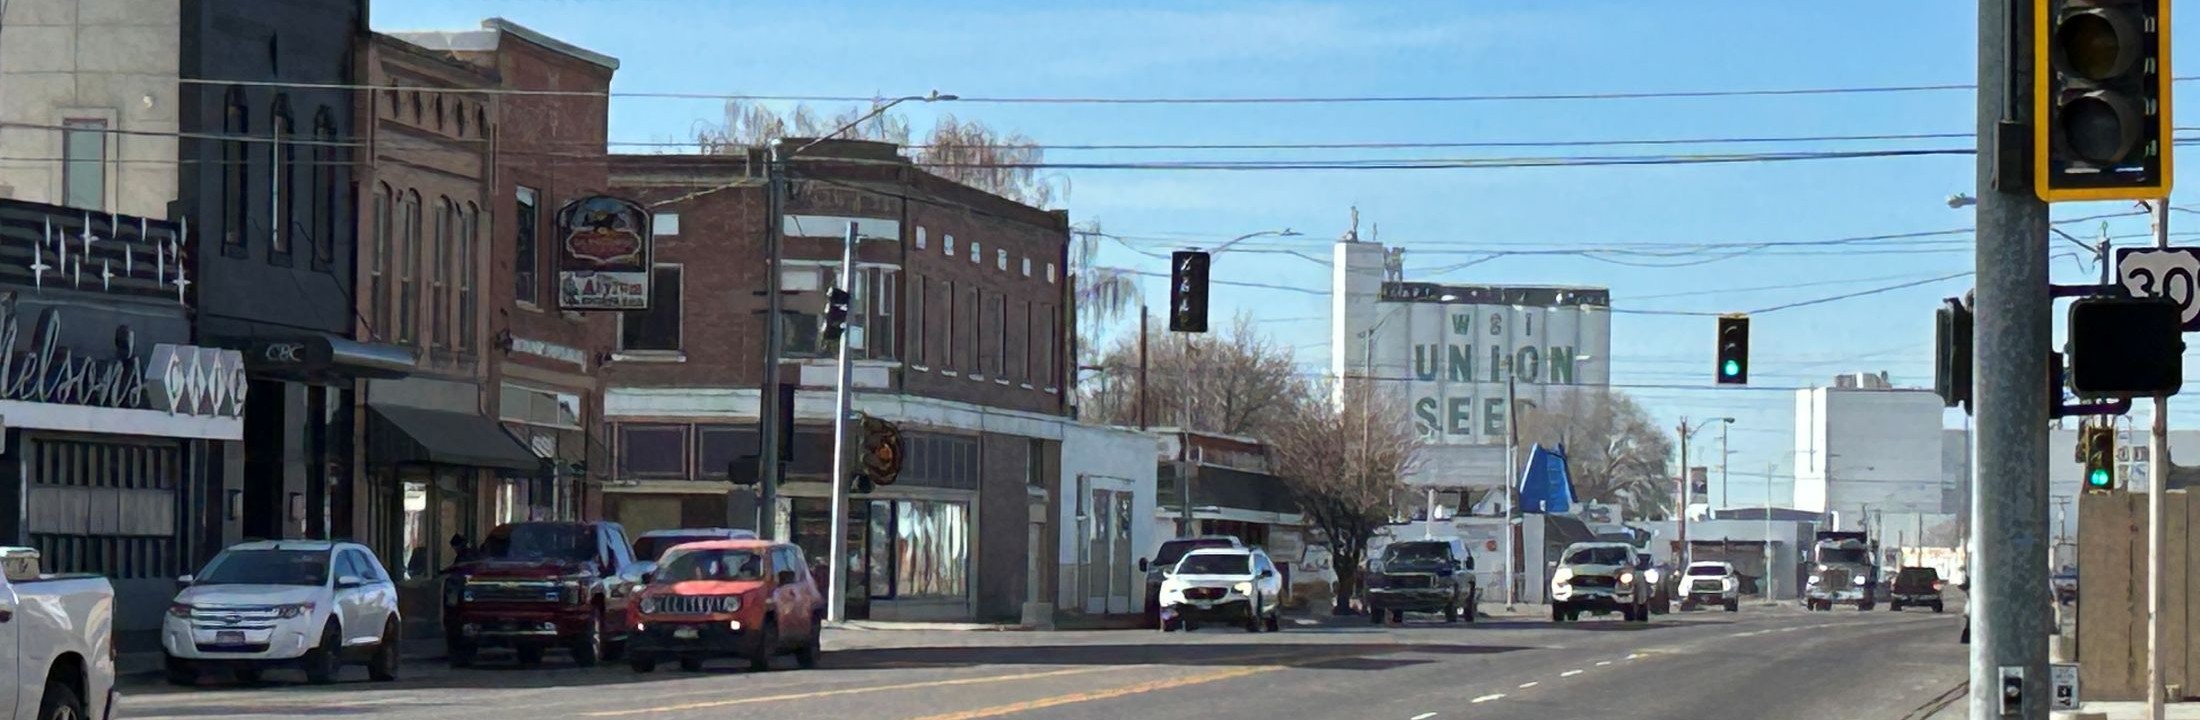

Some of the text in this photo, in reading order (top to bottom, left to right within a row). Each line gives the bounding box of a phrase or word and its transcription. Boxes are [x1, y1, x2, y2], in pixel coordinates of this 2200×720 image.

[2129, 267, 2193, 312] 30
[1414, 344, 1573, 384] UNION
[1415, 396, 1536, 438] SEE
